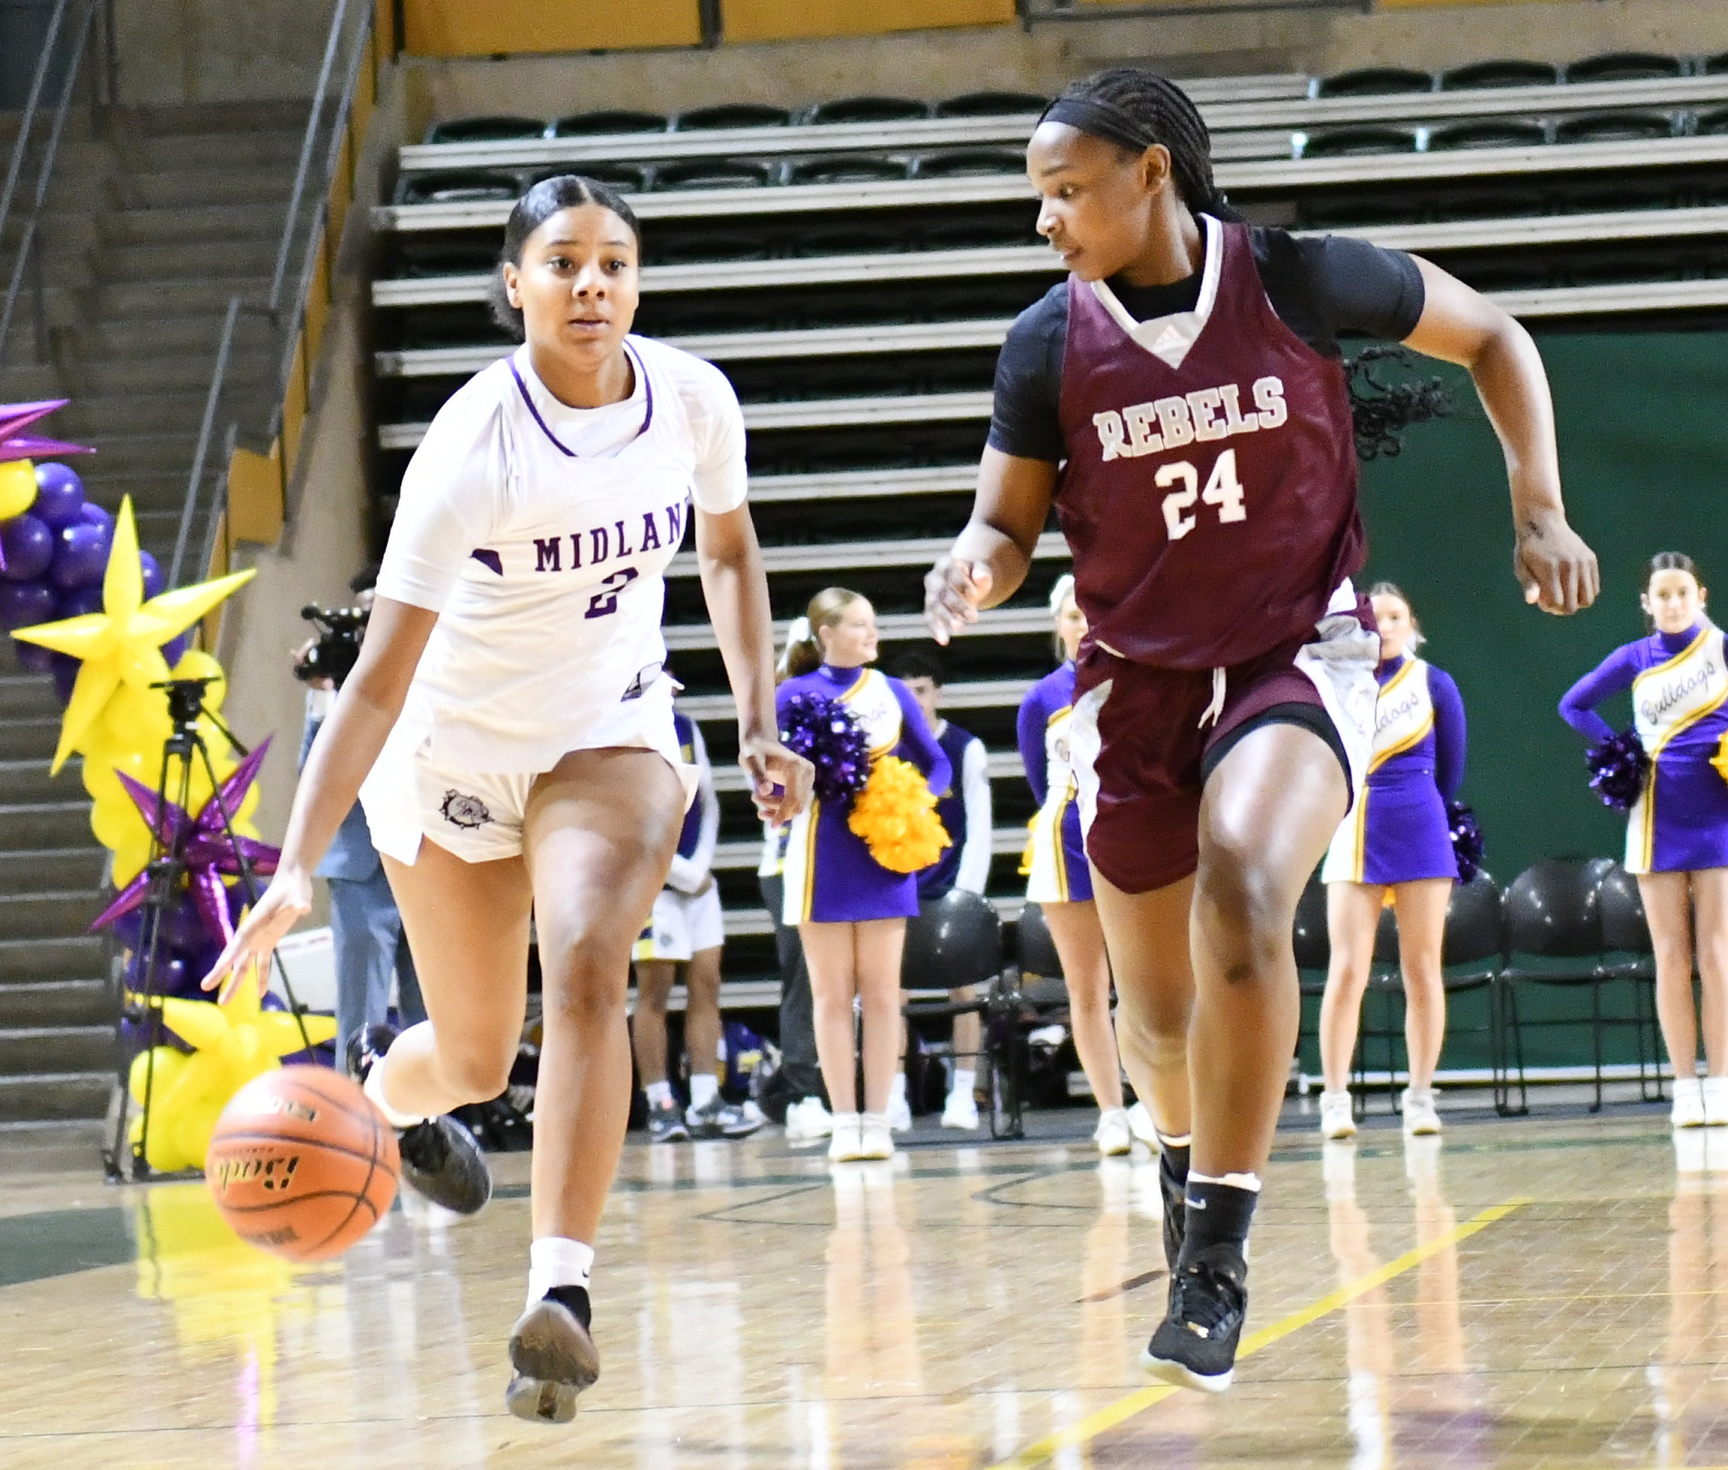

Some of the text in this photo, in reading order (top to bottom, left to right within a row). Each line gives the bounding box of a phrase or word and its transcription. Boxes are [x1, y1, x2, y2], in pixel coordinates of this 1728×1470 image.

[1092, 376, 1288, 462] REBELS
[1154, 448, 1247, 541] 24
[533, 502, 682, 572] MIDLAN
[584, 566, 639, 620] 2
[1641, 661, 1716, 726] Bulldogs
